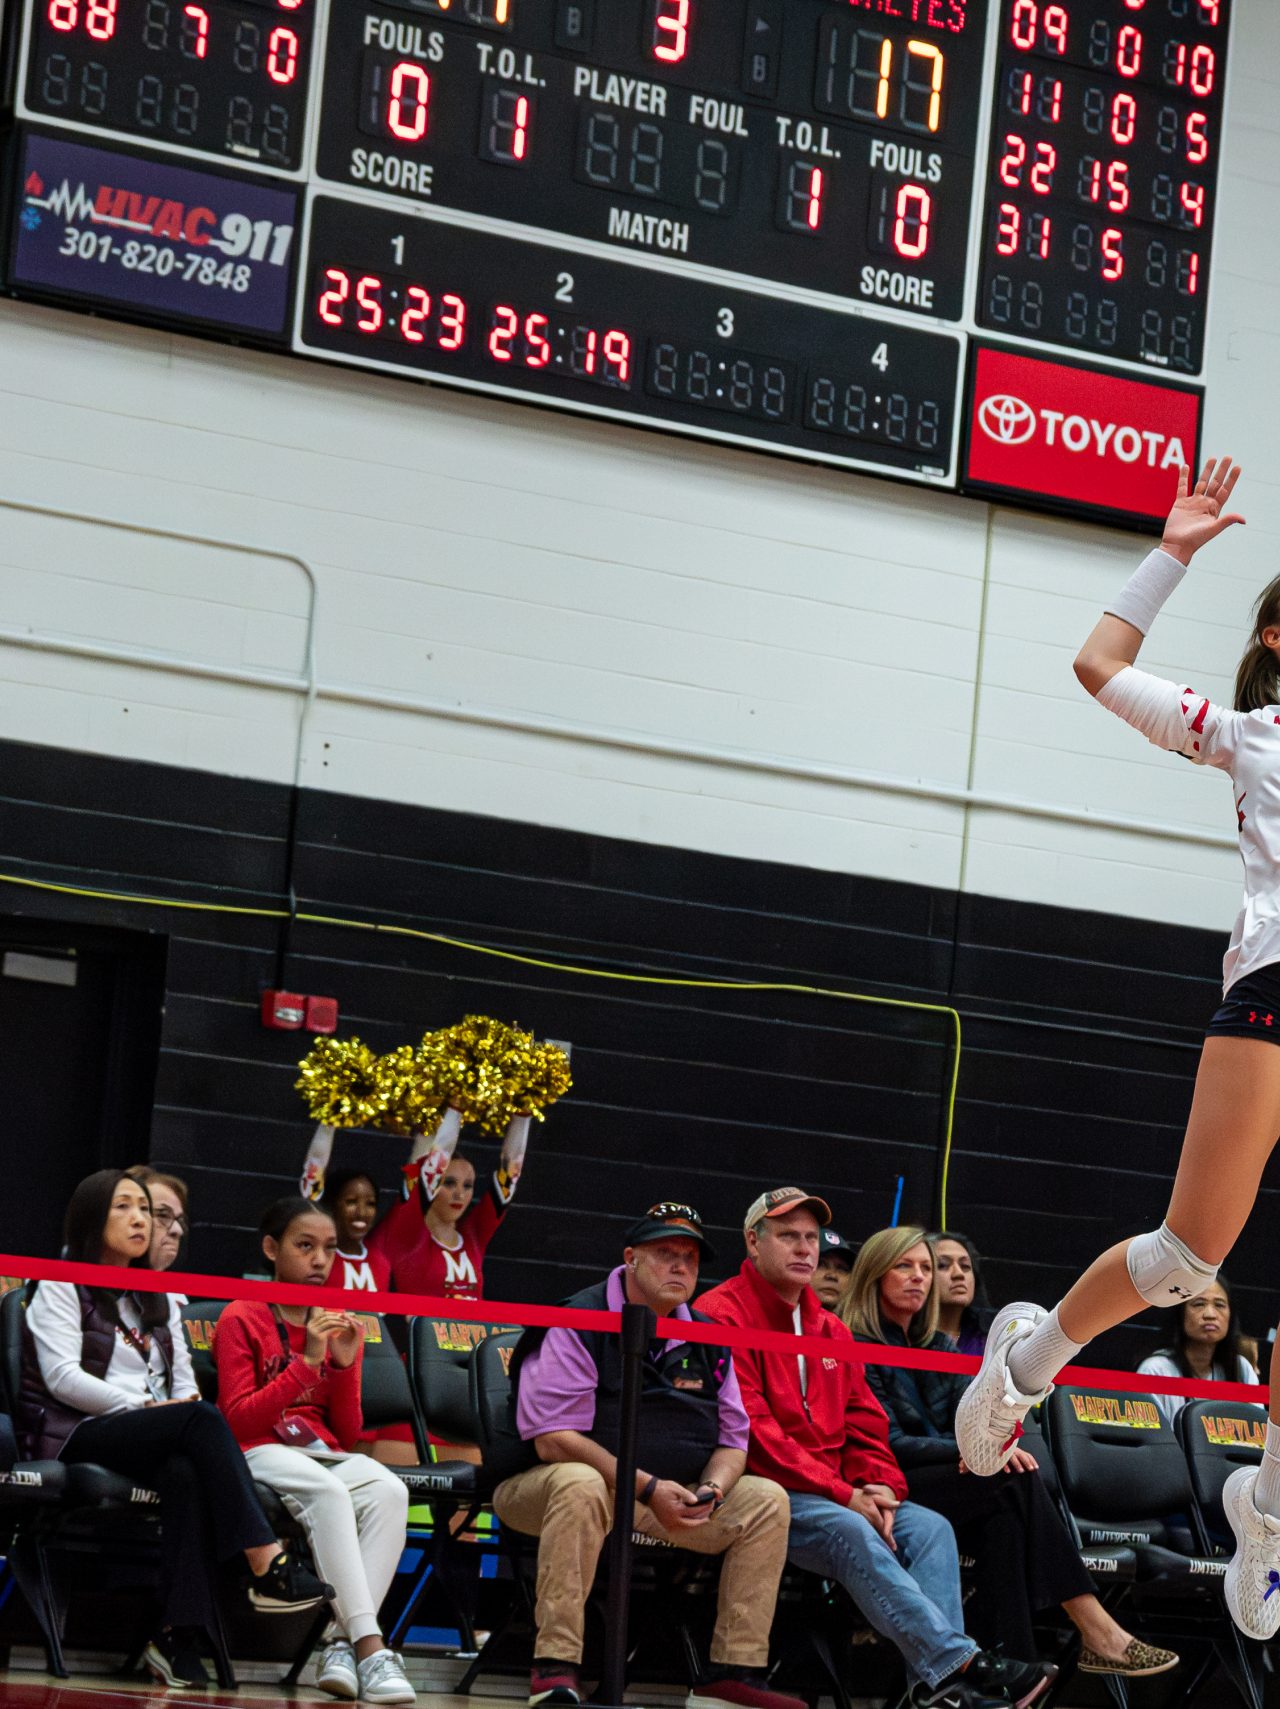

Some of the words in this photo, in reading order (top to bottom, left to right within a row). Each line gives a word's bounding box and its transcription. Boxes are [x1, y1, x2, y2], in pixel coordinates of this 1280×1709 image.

[184, 5, 208, 58] 7
[266, 26, 298, 84] 0
[364, 15, 445, 62] FOULS
[1012, 0, 1068, 54] 09
[1117, 25, 1142, 77] 0
[1176, 44, 1215, 95] 10
[476, 43, 546, 87] T.O.L.
[877, 39, 943, 133] 17
[389, 62, 430, 141] 0
[574, 66, 668, 117] PLAYER
[689, 94, 749, 137] FOUL
[1021, 73, 1062, 123] 11
[1111, 93, 1136, 144] 0
[1186, 112, 1208, 161] 5
[513, 97, 529, 160] 1
[776, 116, 841, 159] T.O.L.
[351, 148, 433, 195] SCORE
[870, 139, 942, 182] FOULS
[1001, 134, 1057, 194] 22
[1091, 160, 1129, 212] 15
[1180, 182, 1204, 227] 4
[808, 167, 822, 230] 1
[894, 183, 931, 258] 0
[92, 185, 216, 246] HVAC
[219, 213, 293, 266] 911
[608, 207, 689, 252] MATCH
[997, 203, 1050, 259] 31
[1102, 228, 1124, 281] 5
[59, 227, 252, 293] 301-820-7848
[391, 235, 404, 265] 1
[555, 272, 574, 303] 2
[860, 266, 934, 308] SCORE
[716, 307, 734, 337] 3
[871, 343, 889, 372] 4
[1040, 409, 1185, 470] TOYOTA
[343, 1261, 378, 1292] M
[442, 1250, 478, 1283] M
[1070, 1394, 1160, 1423] MARYLAND
[1201, 1415, 1267, 1445] MARYLA
